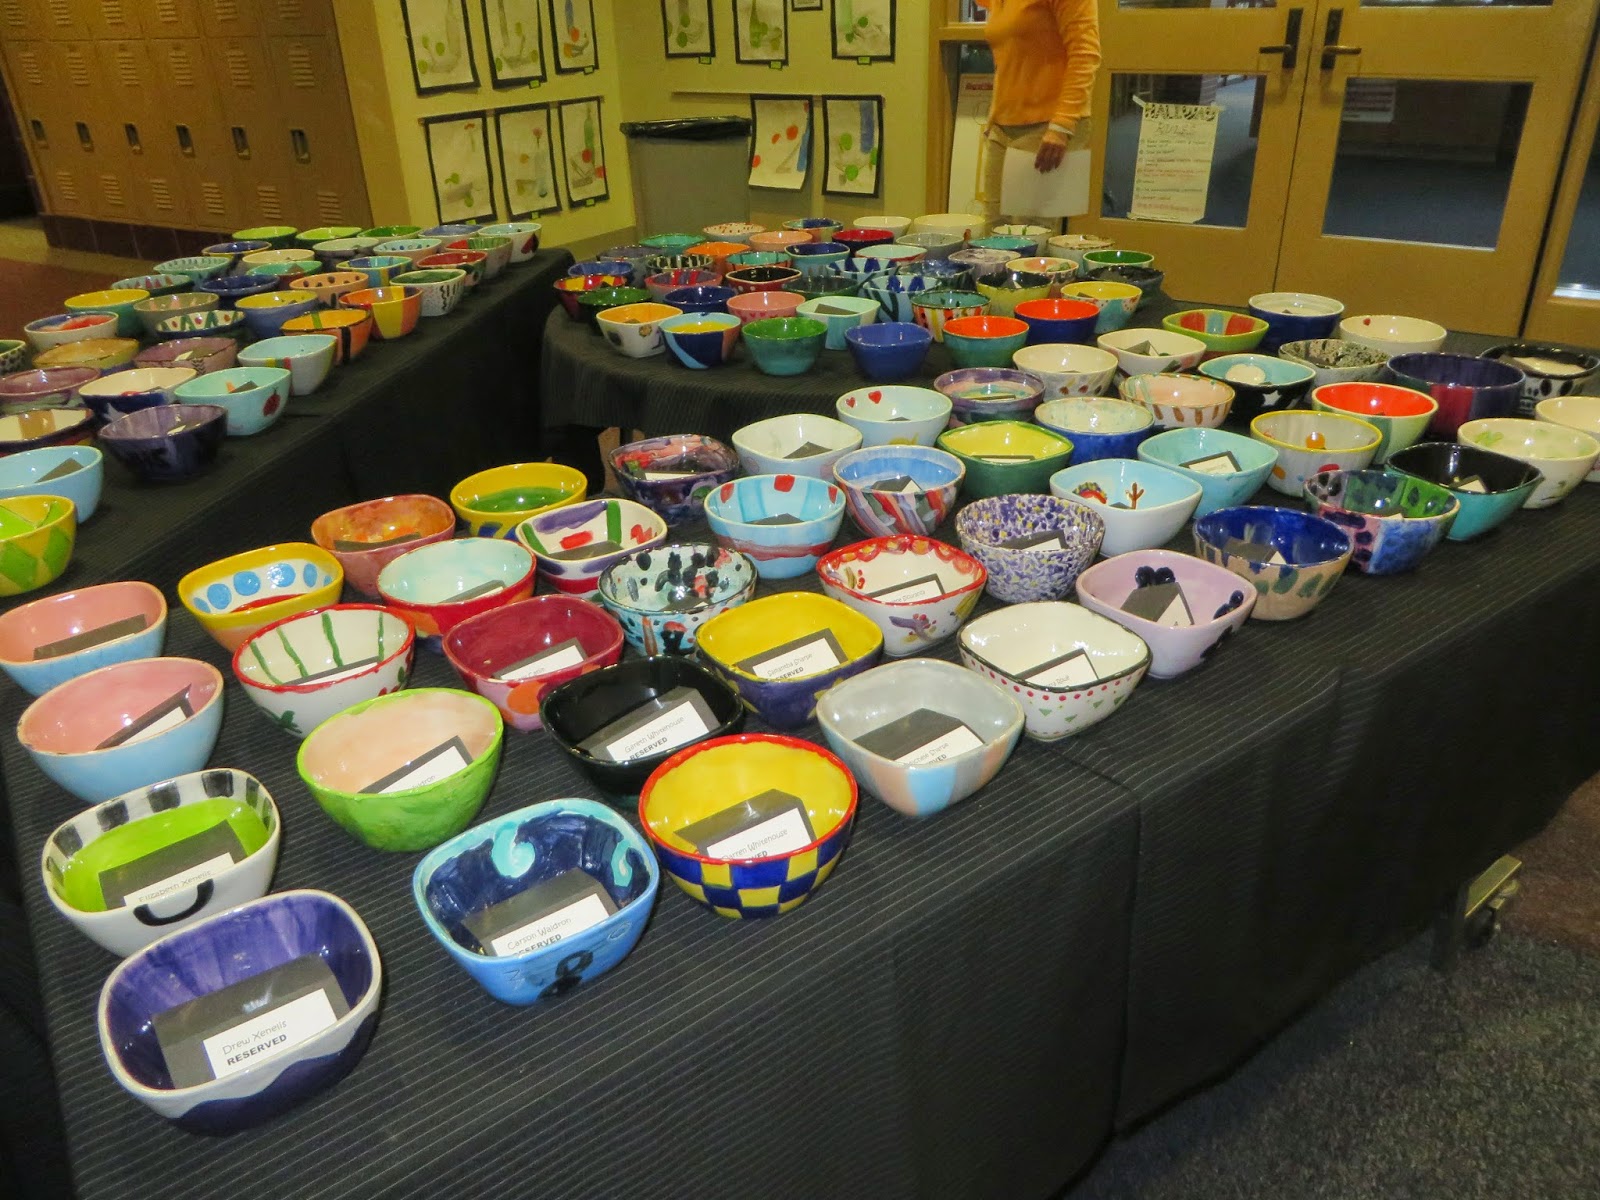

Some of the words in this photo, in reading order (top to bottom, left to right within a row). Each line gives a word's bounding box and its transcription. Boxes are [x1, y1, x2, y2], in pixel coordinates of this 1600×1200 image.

[747, 829, 788, 852] Whitehouse
[139, 884, 180, 902] Elizabeth
[507, 933, 537, 950] Carson
[537, 917, 572, 937] Waldron
[222, 1039, 251, 1055] Drew
[252, 1020, 287, 1041] Xenelis
[227, 1033, 287, 1066] RESERVED
